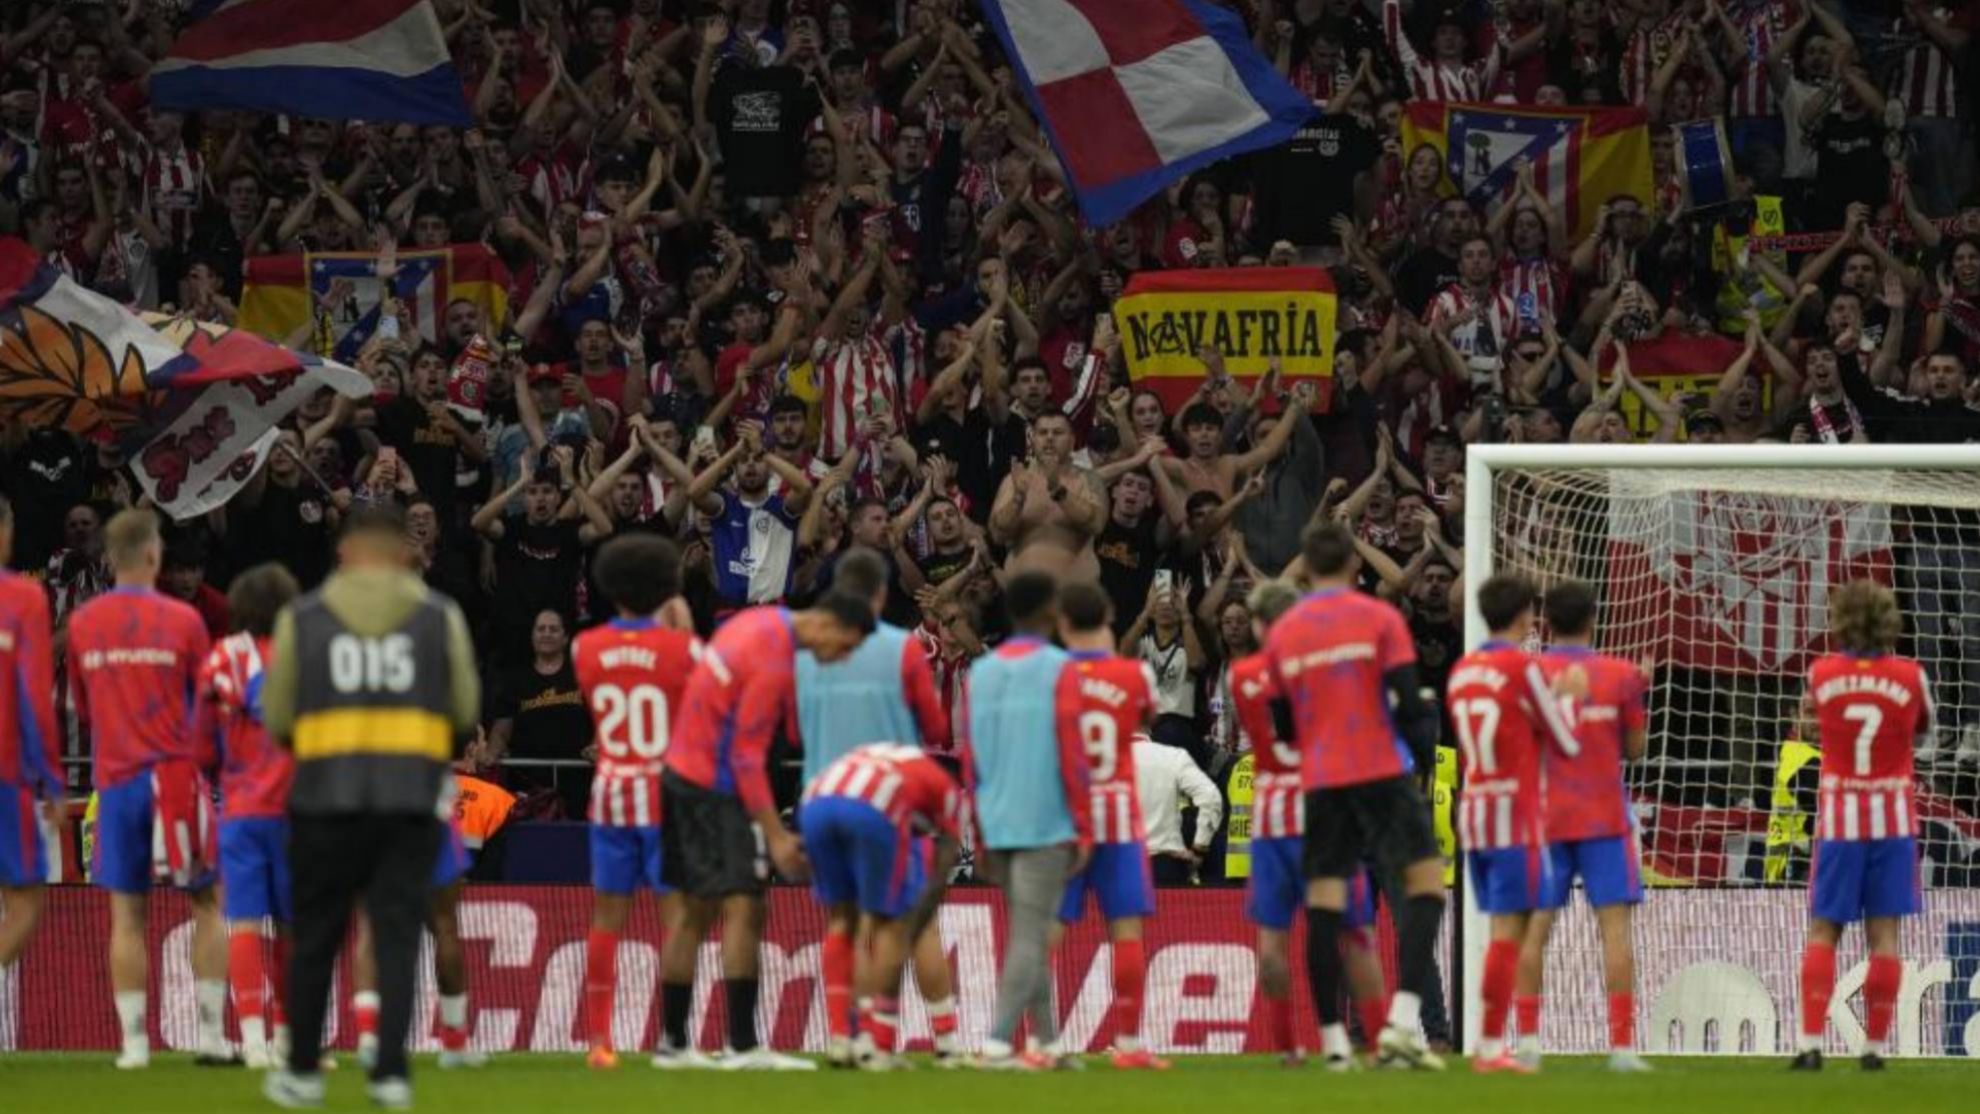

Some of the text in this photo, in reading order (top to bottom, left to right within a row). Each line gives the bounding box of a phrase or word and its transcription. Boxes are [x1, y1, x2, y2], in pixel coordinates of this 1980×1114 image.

[1127, 301, 1323, 360] NAVAFRÍA
[329, 632, 415, 693] 015
[592, 683, 671, 758] 20
[1453, 698, 1500, 775] 17
[1843, 703, 1884, 776] 7
